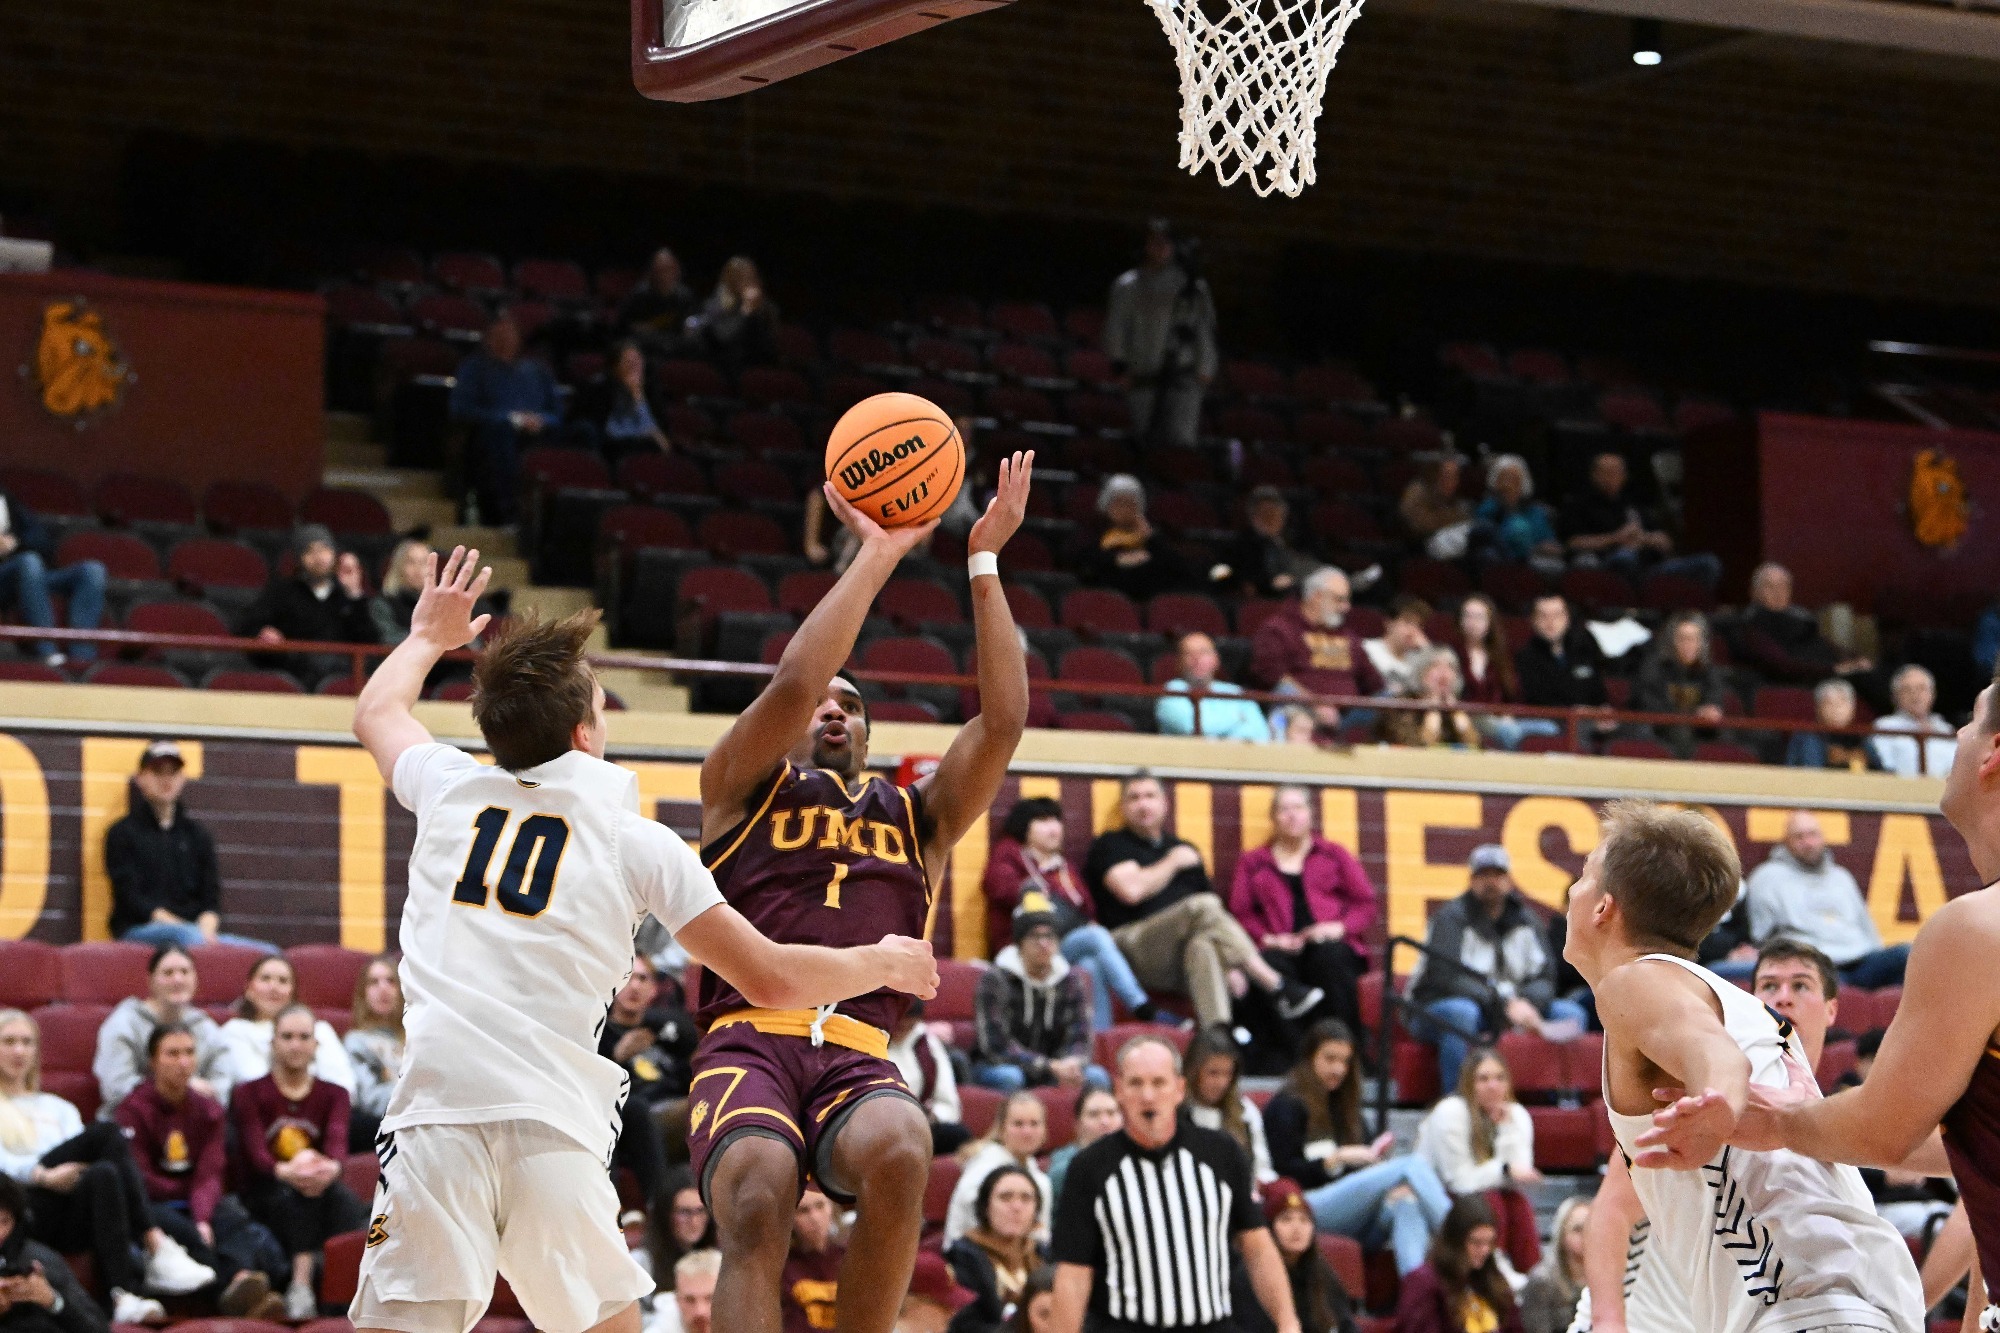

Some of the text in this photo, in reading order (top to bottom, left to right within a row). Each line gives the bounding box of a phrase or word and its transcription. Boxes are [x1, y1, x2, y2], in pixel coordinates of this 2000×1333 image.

[839, 435, 927, 490] Wilson
[451, 804, 572, 920] 10
[769, 805, 909, 865] UMD
[823, 862, 849, 909] 1
